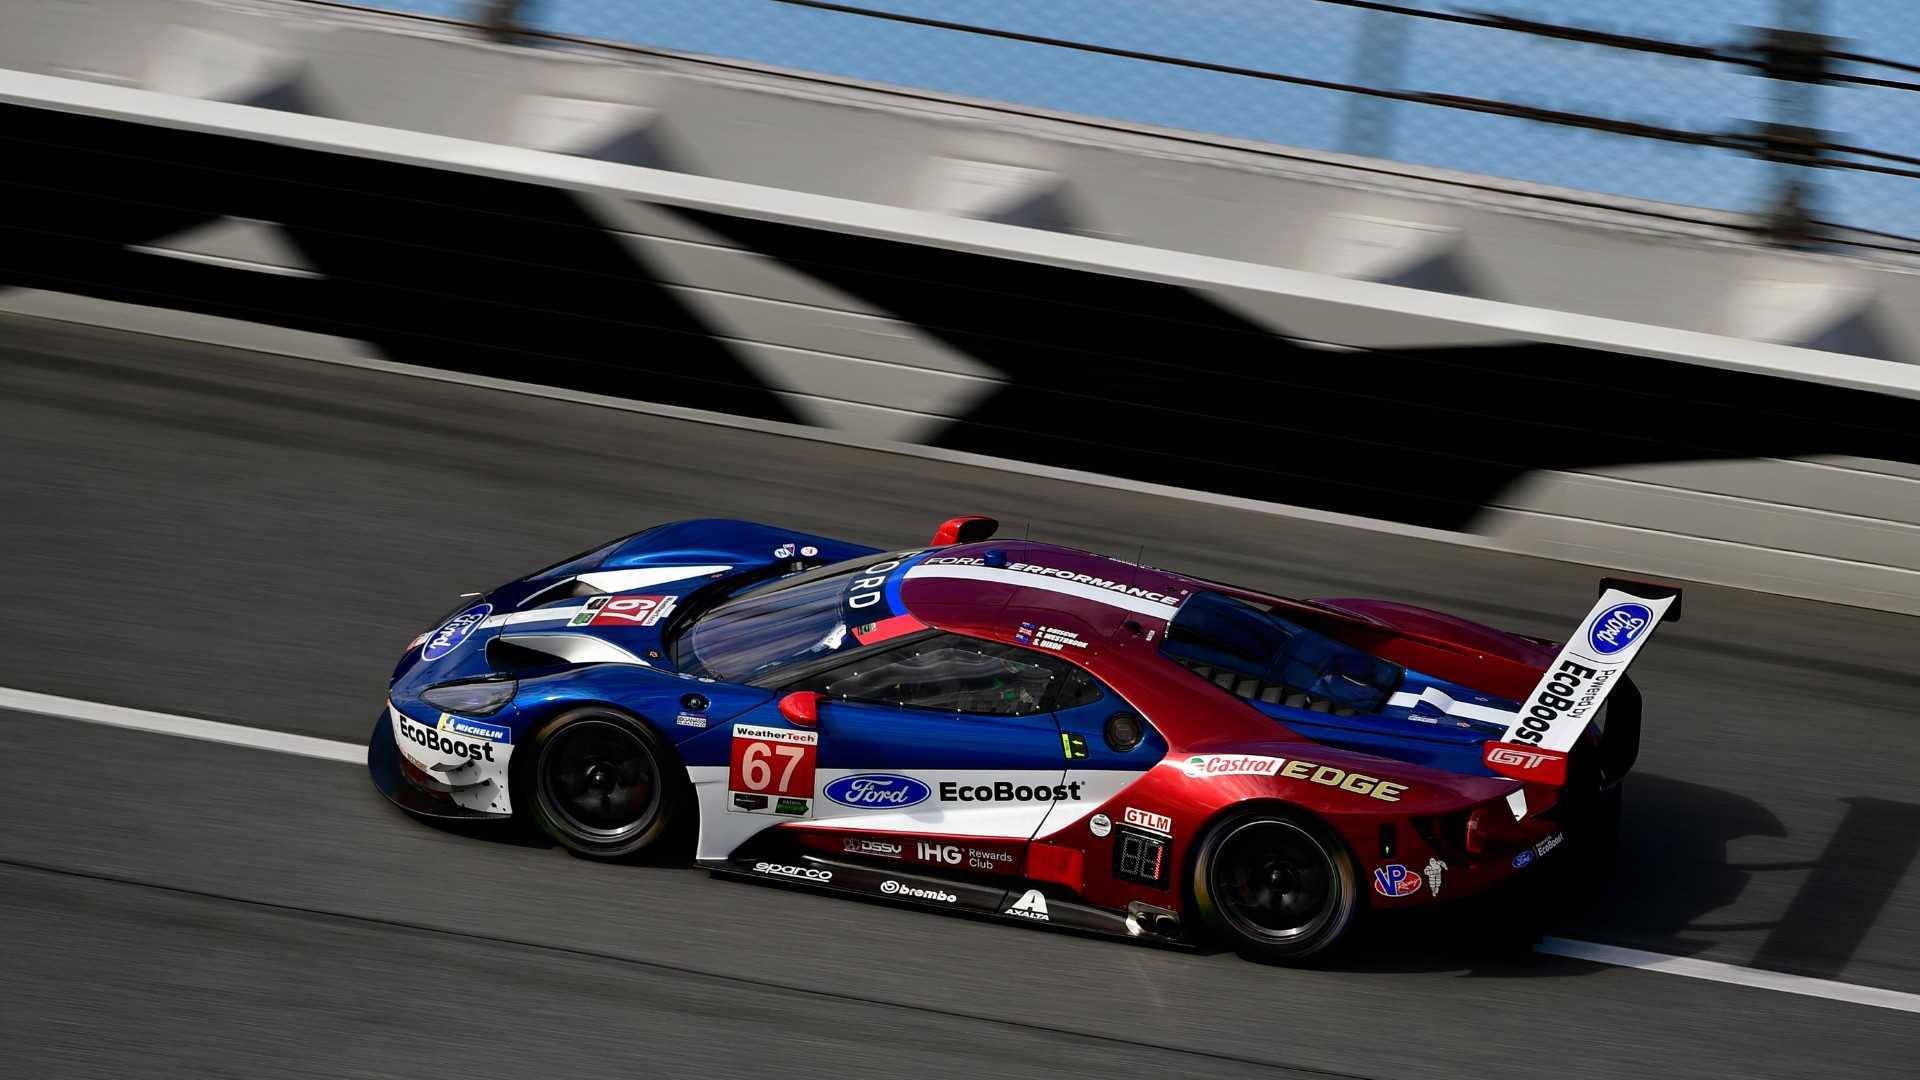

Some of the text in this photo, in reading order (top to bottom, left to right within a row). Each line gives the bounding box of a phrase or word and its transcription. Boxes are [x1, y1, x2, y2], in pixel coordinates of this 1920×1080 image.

[1005, 562, 1181, 606] ERFORMANCE
[599, 599, 657, 622] 67
[429, 611, 486, 650] Ford
[1595, 609, 1646, 647] Ford
[1567, 668, 1617, 719] Powered by
[400, 717, 495, 762] EcoBoost
[455, 724, 503, 739] MICHELIN
[737, 727, 816, 743] WeatherTech
[742, 742, 805, 793] 67
[1487, 748, 1564, 769] GT
[1206, 757, 1409, 802] Castrol EDGE
[843, 777, 910, 805] Ford
[939, 781, 1084, 802] EcoBoost
[1127, 809, 1169, 831] GTLM
[861, 839, 902, 854] DSSV
[917, 842, 963, 865] IHG
[969, 848, 1013, 862] Rewards
[754, 862, 833, 882] sparco
[969, 857, 994, 870] Club
[1374, 864, 1407, 896] VP
[899, 884, 957, 903] brembo
[1004, 908, 1050, 921] AXALTA
